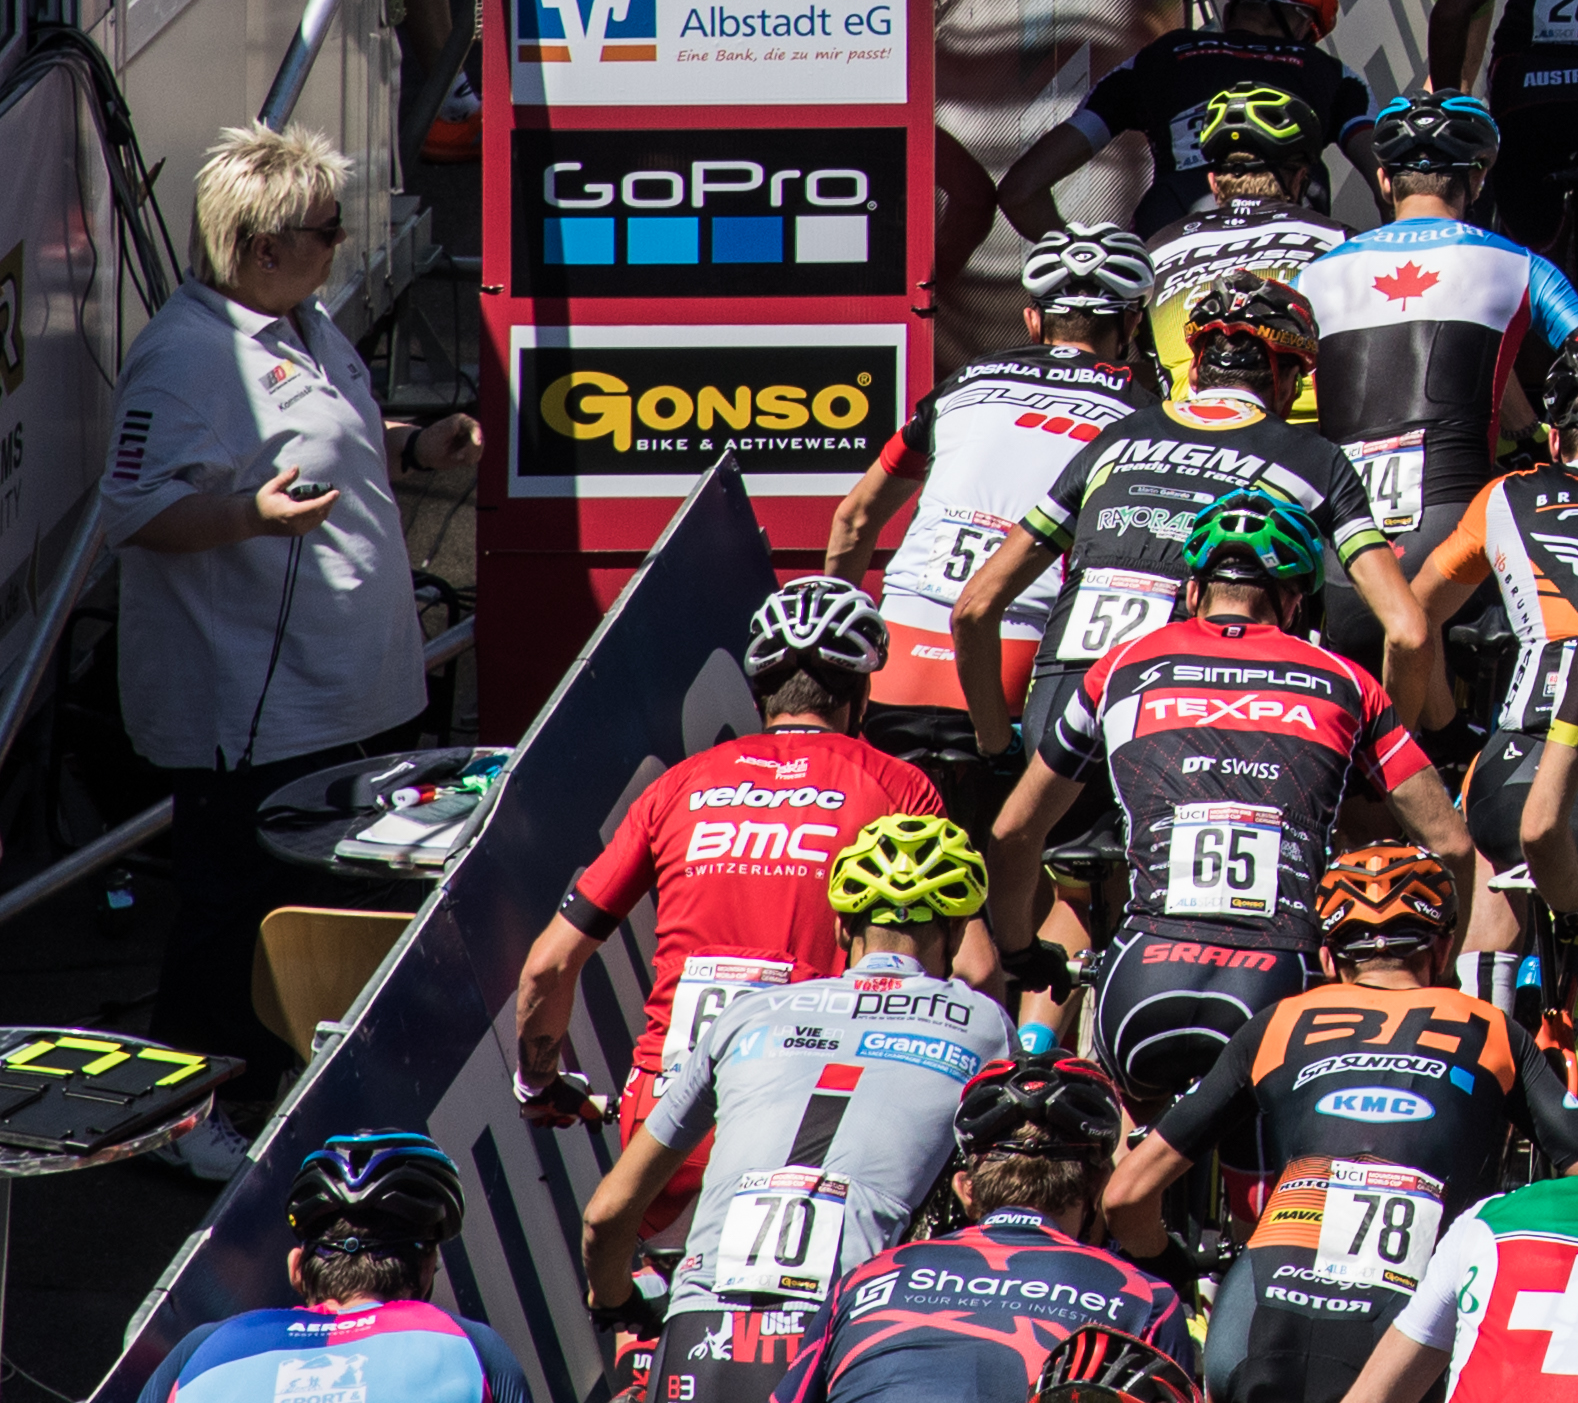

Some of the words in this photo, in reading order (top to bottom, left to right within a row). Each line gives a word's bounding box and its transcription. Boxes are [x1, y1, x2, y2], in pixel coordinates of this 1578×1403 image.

[679, 6, 832, 39] Albstadt
[843, 10, 892, 37] eG
[676, 48, 711, 63] Eine
[716, 48, 757, 64] Bank,
[763, 48, 786, 62] die
[791, 51, 809, 62] zu
[815, 48, 842, 62] mir
[846, 47, 892, 64] passt!
[543, 161, 868, 208] GoPro
[1348, 222, 1487, 248] Canada
[958, 362, 1042, 383] JOSHUA
[1048, 367, 1124, 391] DUBAU
[541, 371, 869, 452] GONSO
[637, 438, 690, 451] BIKE
[700, 438, 713, 451] &
[723, 437, 867, 451] ACTIVEWEAR
[1118, 438, 1261, 483] MGM
[1173, 664, 1331, 694] SIMPLON
[1145, 695, 1316, 731] TEXPA
[1182, 756, 1217, 774] DT
[1221, 758, 1279, 780] SWISS
[689, 782, 845, 811] veloroc
[685, 821, 840, 861] BMC
[685, 865, 808, 877] SWITZERLAND
[1192, 828, 1260, 891] 65
[1333, 1096, 1417, 1117] KMC
[747, 1196, 816, 1268] 70
[1347, 1192, 1416, 1265] 78
[908, 1268, 1125, 1321] Sharenet
